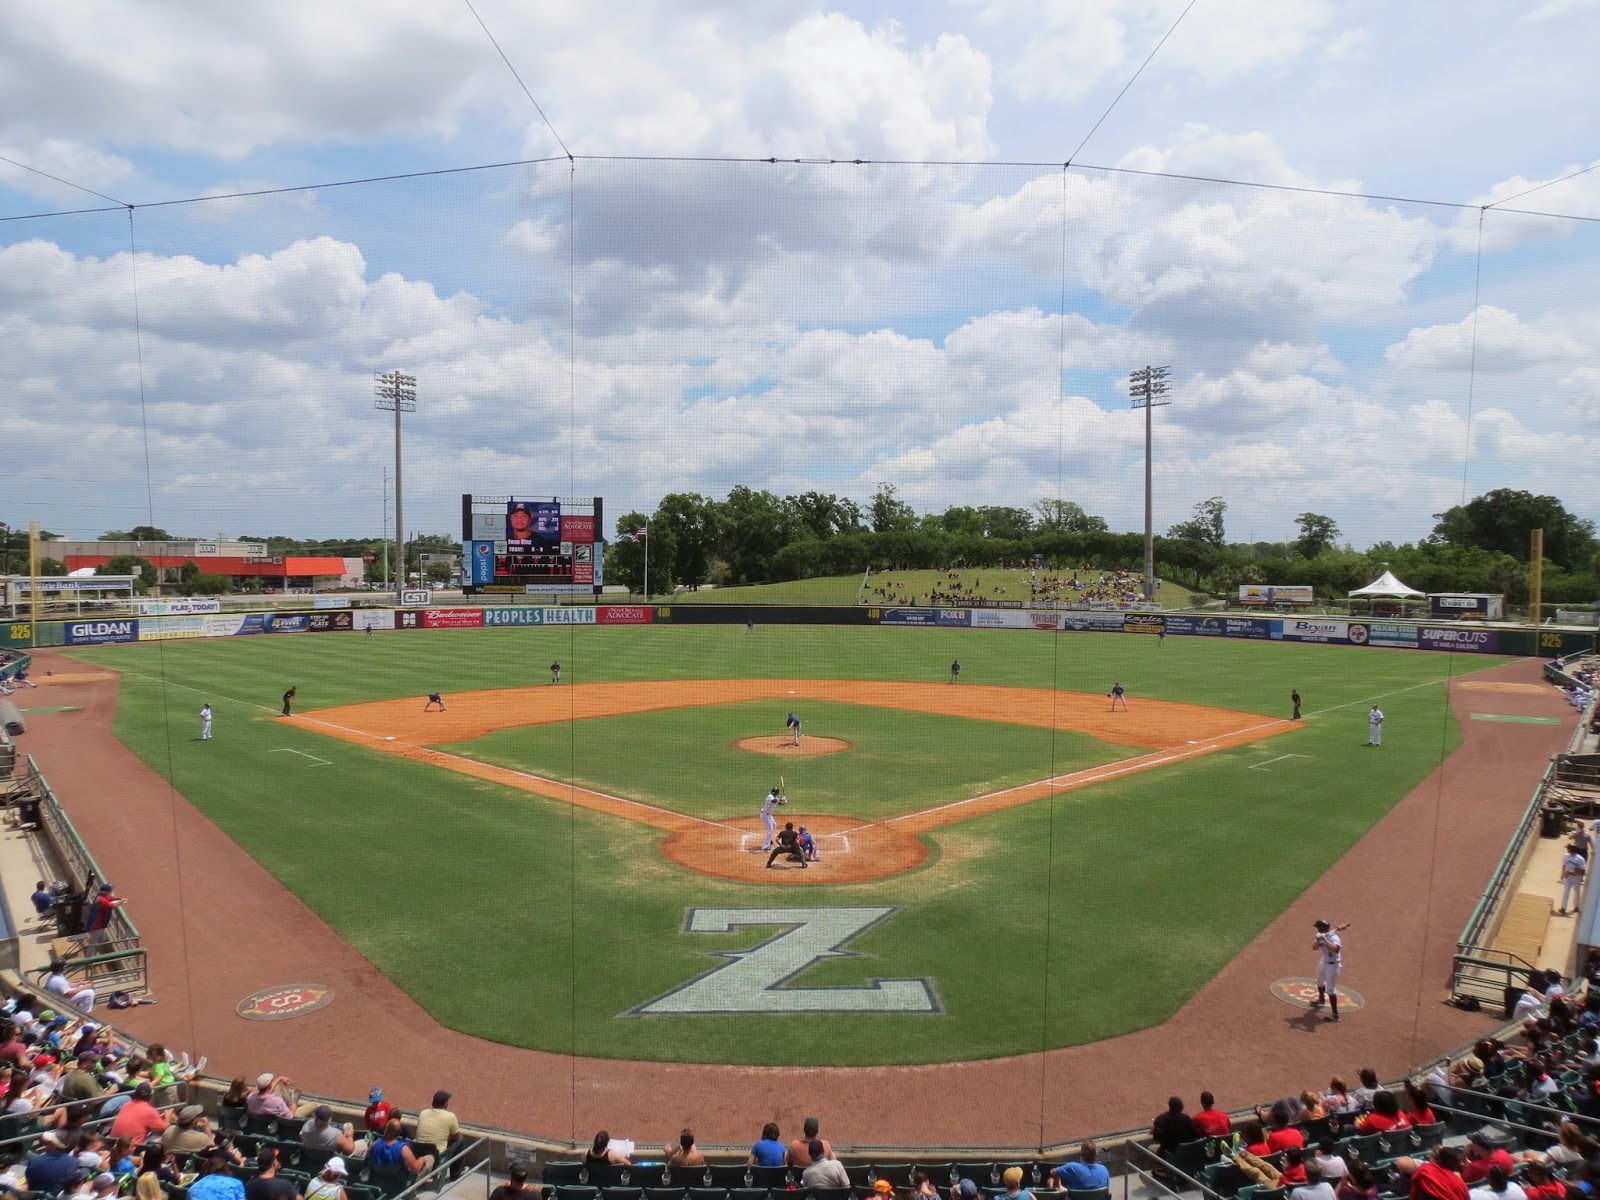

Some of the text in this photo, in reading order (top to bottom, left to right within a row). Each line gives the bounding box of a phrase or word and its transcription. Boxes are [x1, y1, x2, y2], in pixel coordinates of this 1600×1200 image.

[405, 593, 426, 602] CST
[426, 611, 481, 619] Budweiser
[486, 610, 592, 623] PEOPLES HEALTH
[867, 609, 879, 618] 400
[941, 610, 957, 619] FOX
[11, 625, 30, 639] 325
[72, 623, 131, 636] GILDAN
[1296, 622, 1336, 633] Bryan
[1422, 629, 1488, 643] SUPERCUTS
[1541, 634, 1562, 648] 325
[622, 906, 944, 1015] Z
